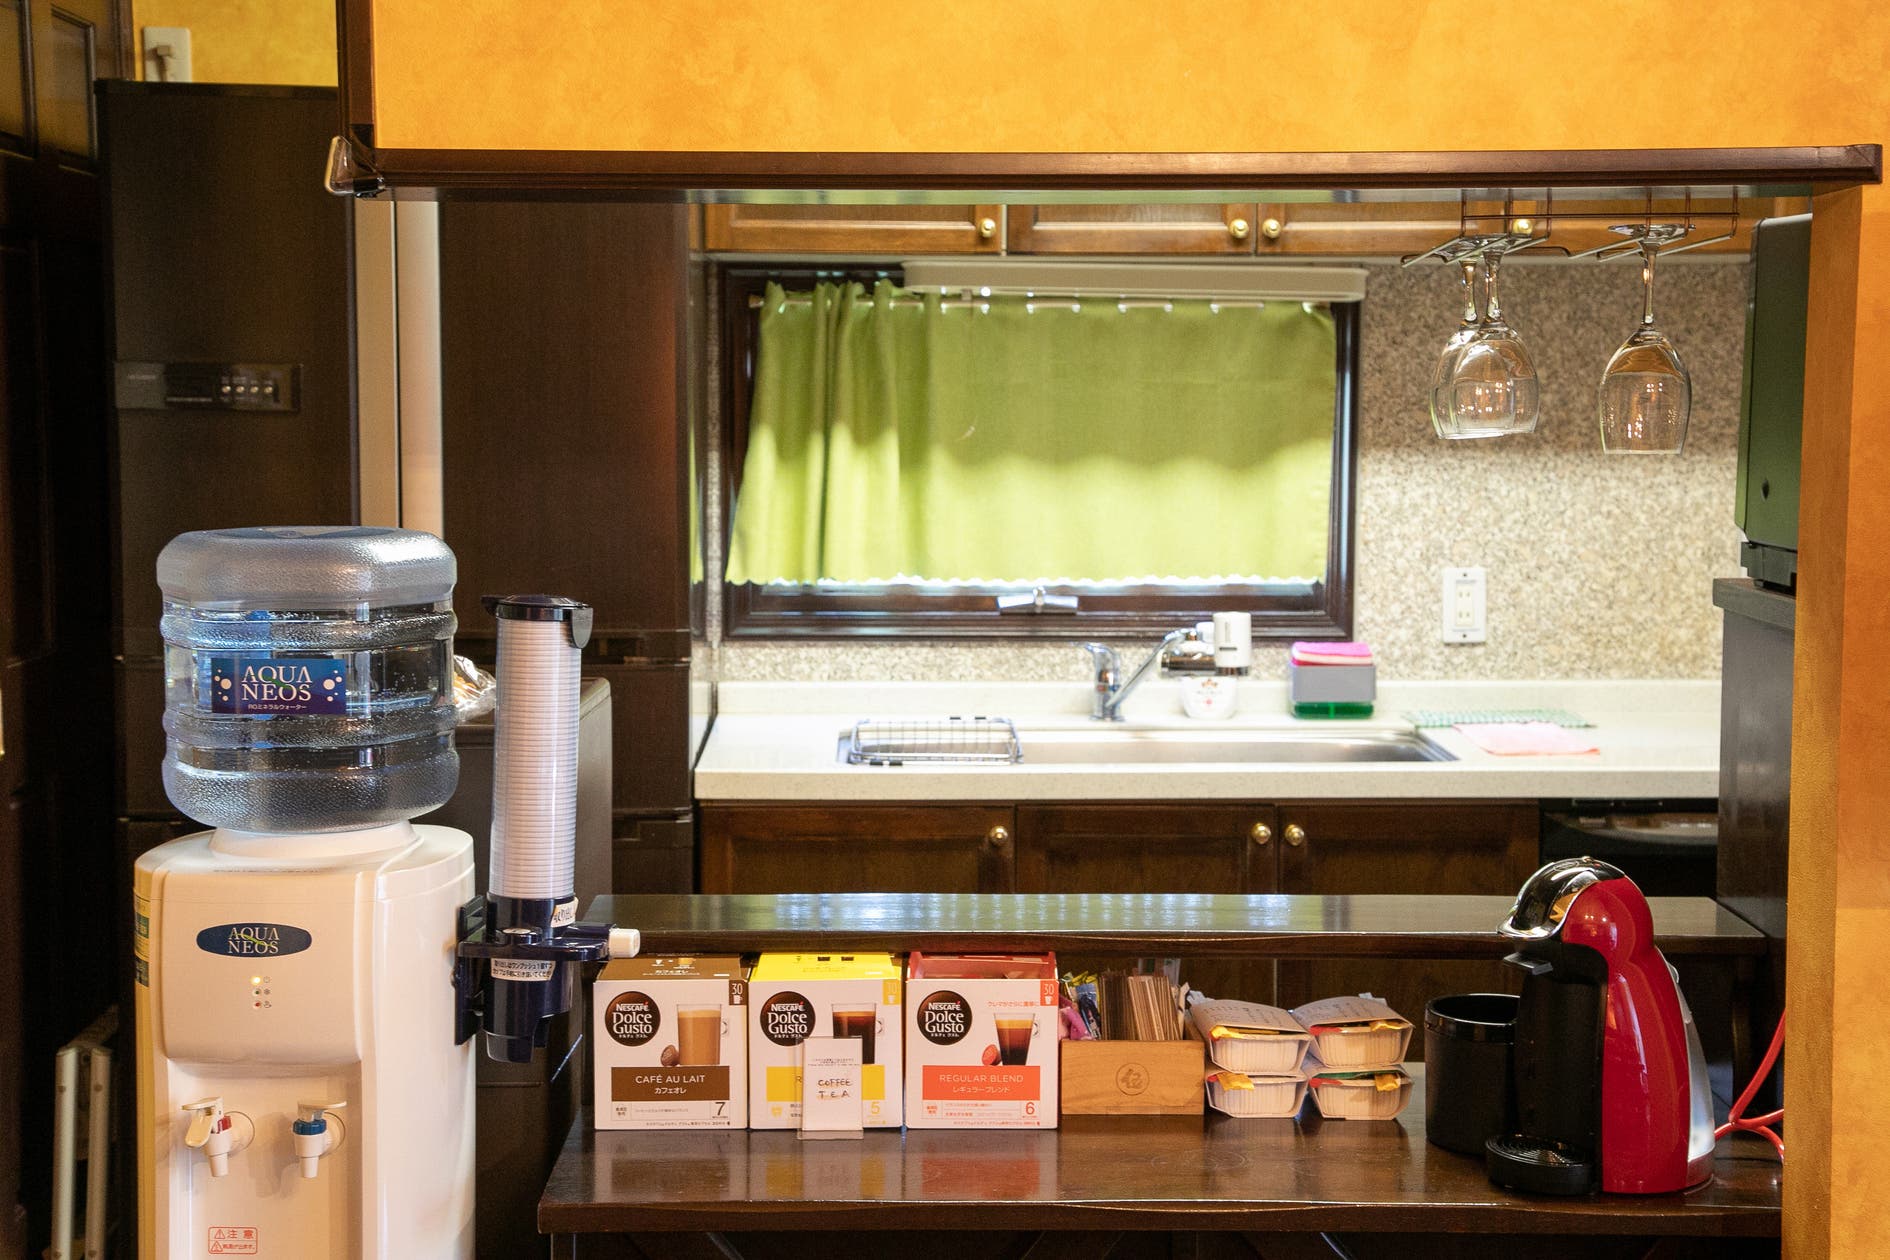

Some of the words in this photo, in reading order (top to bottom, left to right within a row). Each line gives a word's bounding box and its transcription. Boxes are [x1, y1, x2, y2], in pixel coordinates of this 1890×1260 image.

[242, 665, 313, 683] AQUA
[242, 684, 312, 702] NEOS
[228, 926, 280, 941] AQUA
[228, 941, 280, 954] NEOS
[732, 983, 743, 995] 30
[1044, 984, 1055, 995] 30
[616, 1002, 649, 1012] NESCAFÉ
[928, 1001, 961, 1011] NESCAFÉ
[612, 1011, 652, 1025] Dolce
[767, 1012, 808, 1025] Dolce
[924, 1011, 964, 1024] Dolce
[612, 1023, 653, 1035] Gusto
[768, 1023, 809, 1035] Gusto
[925, 1022, 965, 1034] Gusto
[635, 1073, 663, 1083] CAFÉ
[665, 1075, 681, 1083] AU
[683, 1074, 706, 1083] LAIT
[939, 1075, 986, 1083] REGULAR
[989, 1075, 1024, 1083] BLEND
[654, 1087, 687, 1095] カフェオレ
[952, 1085, 1011, 1094] レギュラーブレンド
[715, 1102, 726, 1116] 7
[871, 1102, 880, 1114] 5
[1025, 1102, 1035, 1115] 6
